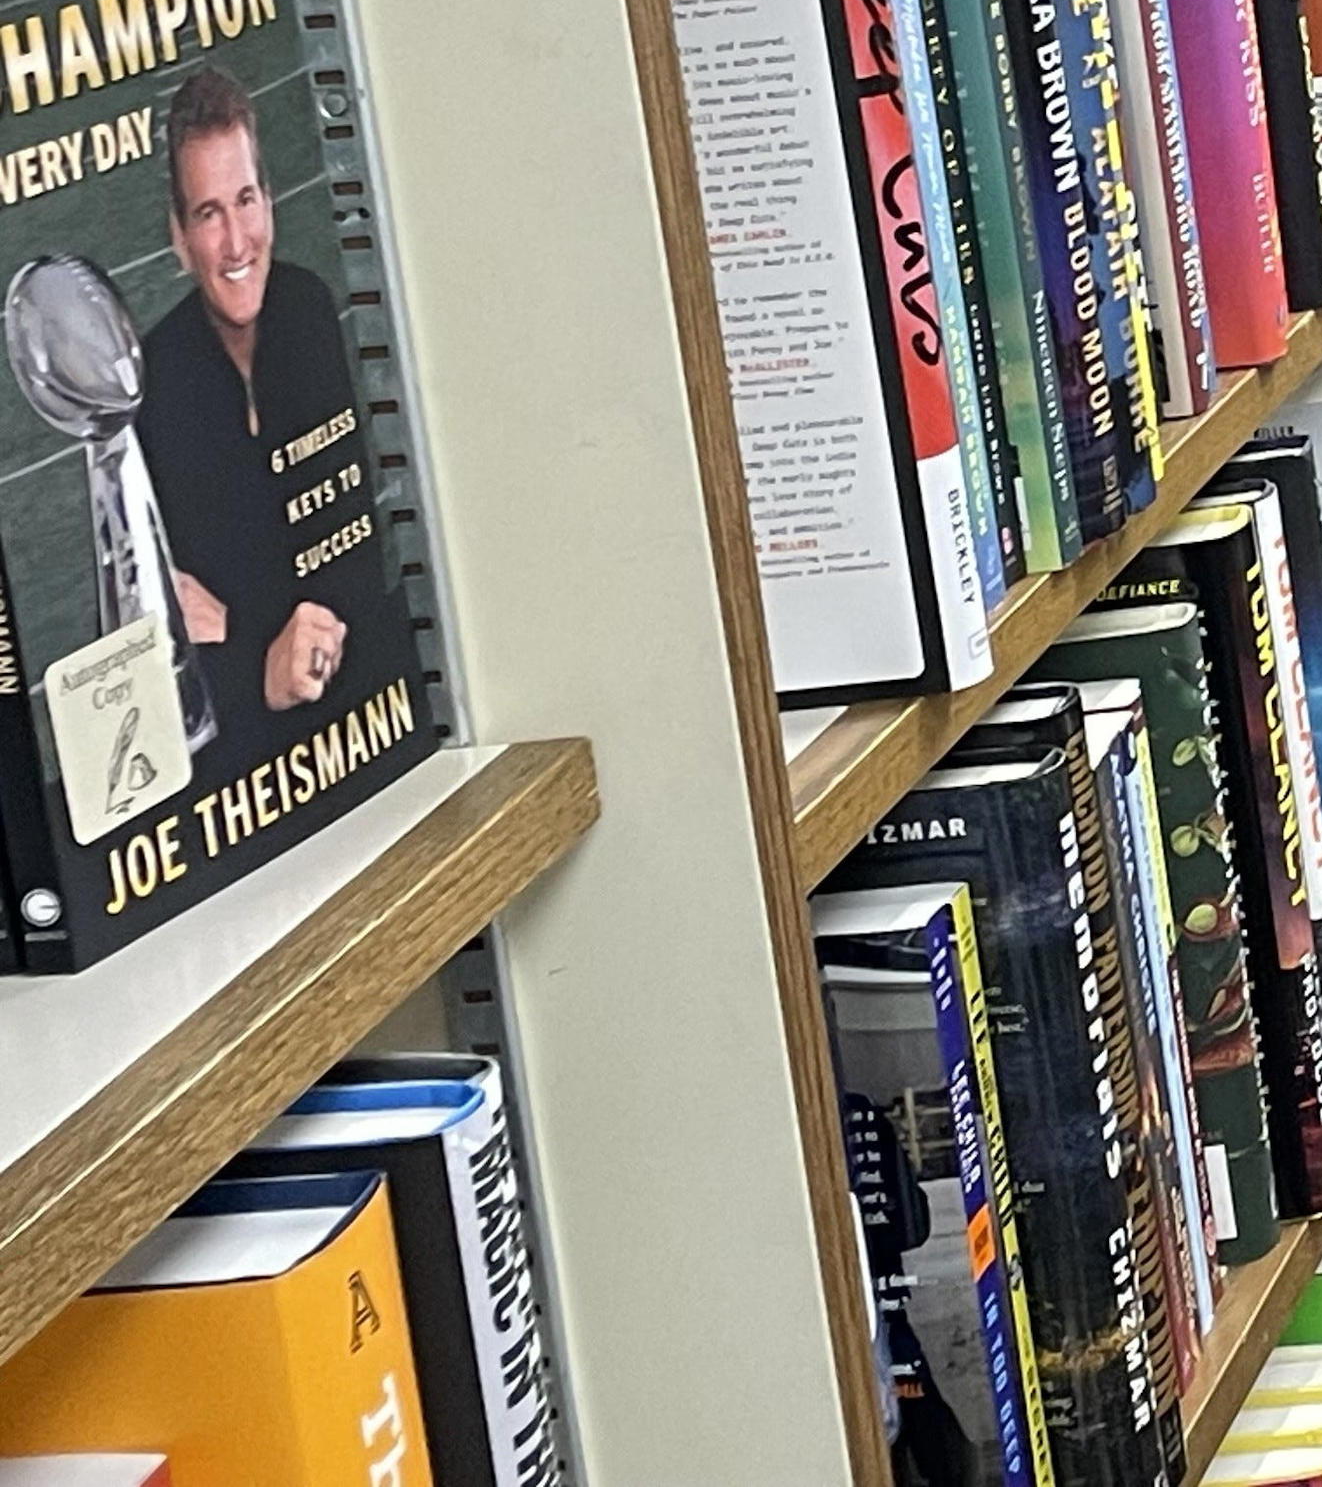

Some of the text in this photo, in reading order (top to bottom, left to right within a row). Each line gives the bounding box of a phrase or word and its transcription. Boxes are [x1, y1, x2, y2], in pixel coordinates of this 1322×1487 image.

[93, 106, 154, 175] DAY
[942, 127, 958, 177] OF
[1035, 39, 1080, 193] BROWN
[1062, 200, 1100, 323] BLOOD
[1081, 329, 1115, 439] MOON
[284, 408, 358, 467] TIMELESS
[882, 153, 943, 367] Cuts
[946, 487, 977, 606] BRICKLEY
[285, 462, 364, 525] KEYS TO
[294, 513, 373, 578] SUCCESS
[106, 677, 417, 916] JOE THEISMANN
[1262, 694, 1306, 908] CLANCY
[1058, 811, 1122, 1180] memorials
[1109, 1225, 1151, 1434] CHIZMAR
[996, 1404, 1026, 1475] DEEP
